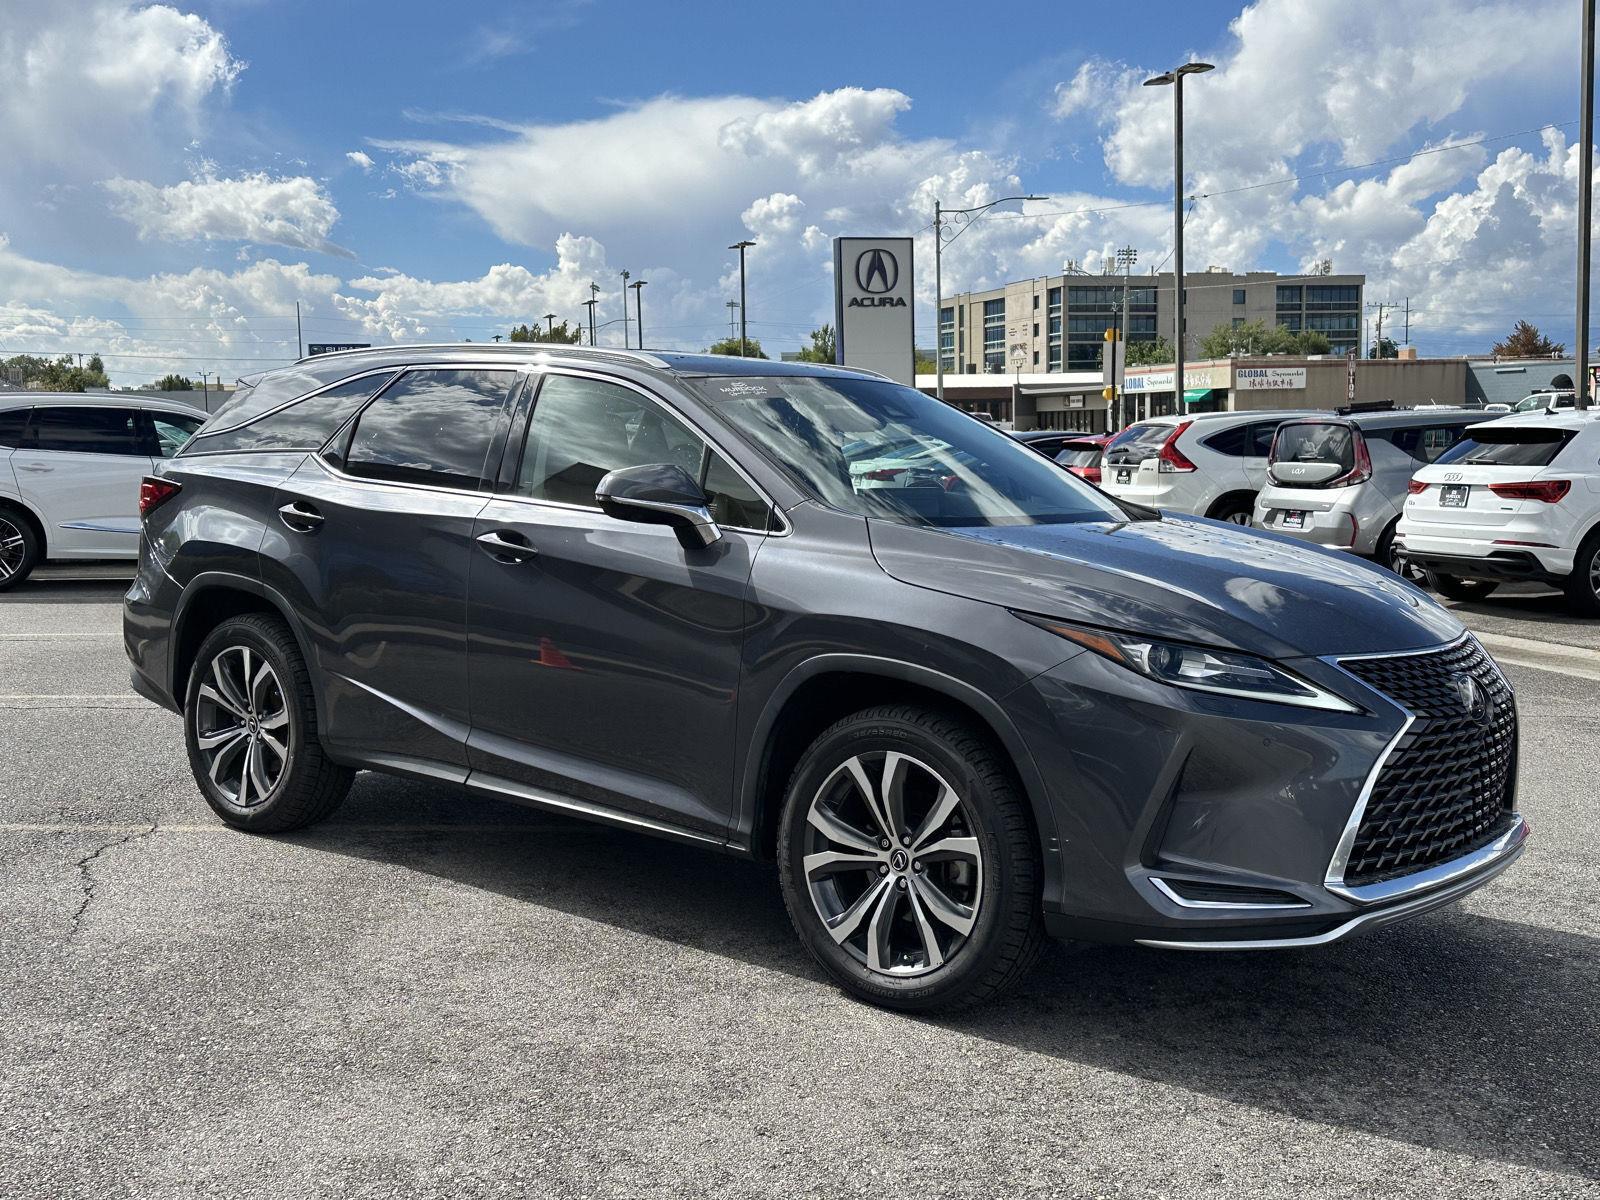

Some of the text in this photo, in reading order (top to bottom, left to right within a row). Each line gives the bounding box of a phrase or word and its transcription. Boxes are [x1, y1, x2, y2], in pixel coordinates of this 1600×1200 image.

[848, 297, 907, 307] ACURA
[1238, 369, 1268, 378] GLOBAL
[1124, 377, 1144, 389] LOBAL
